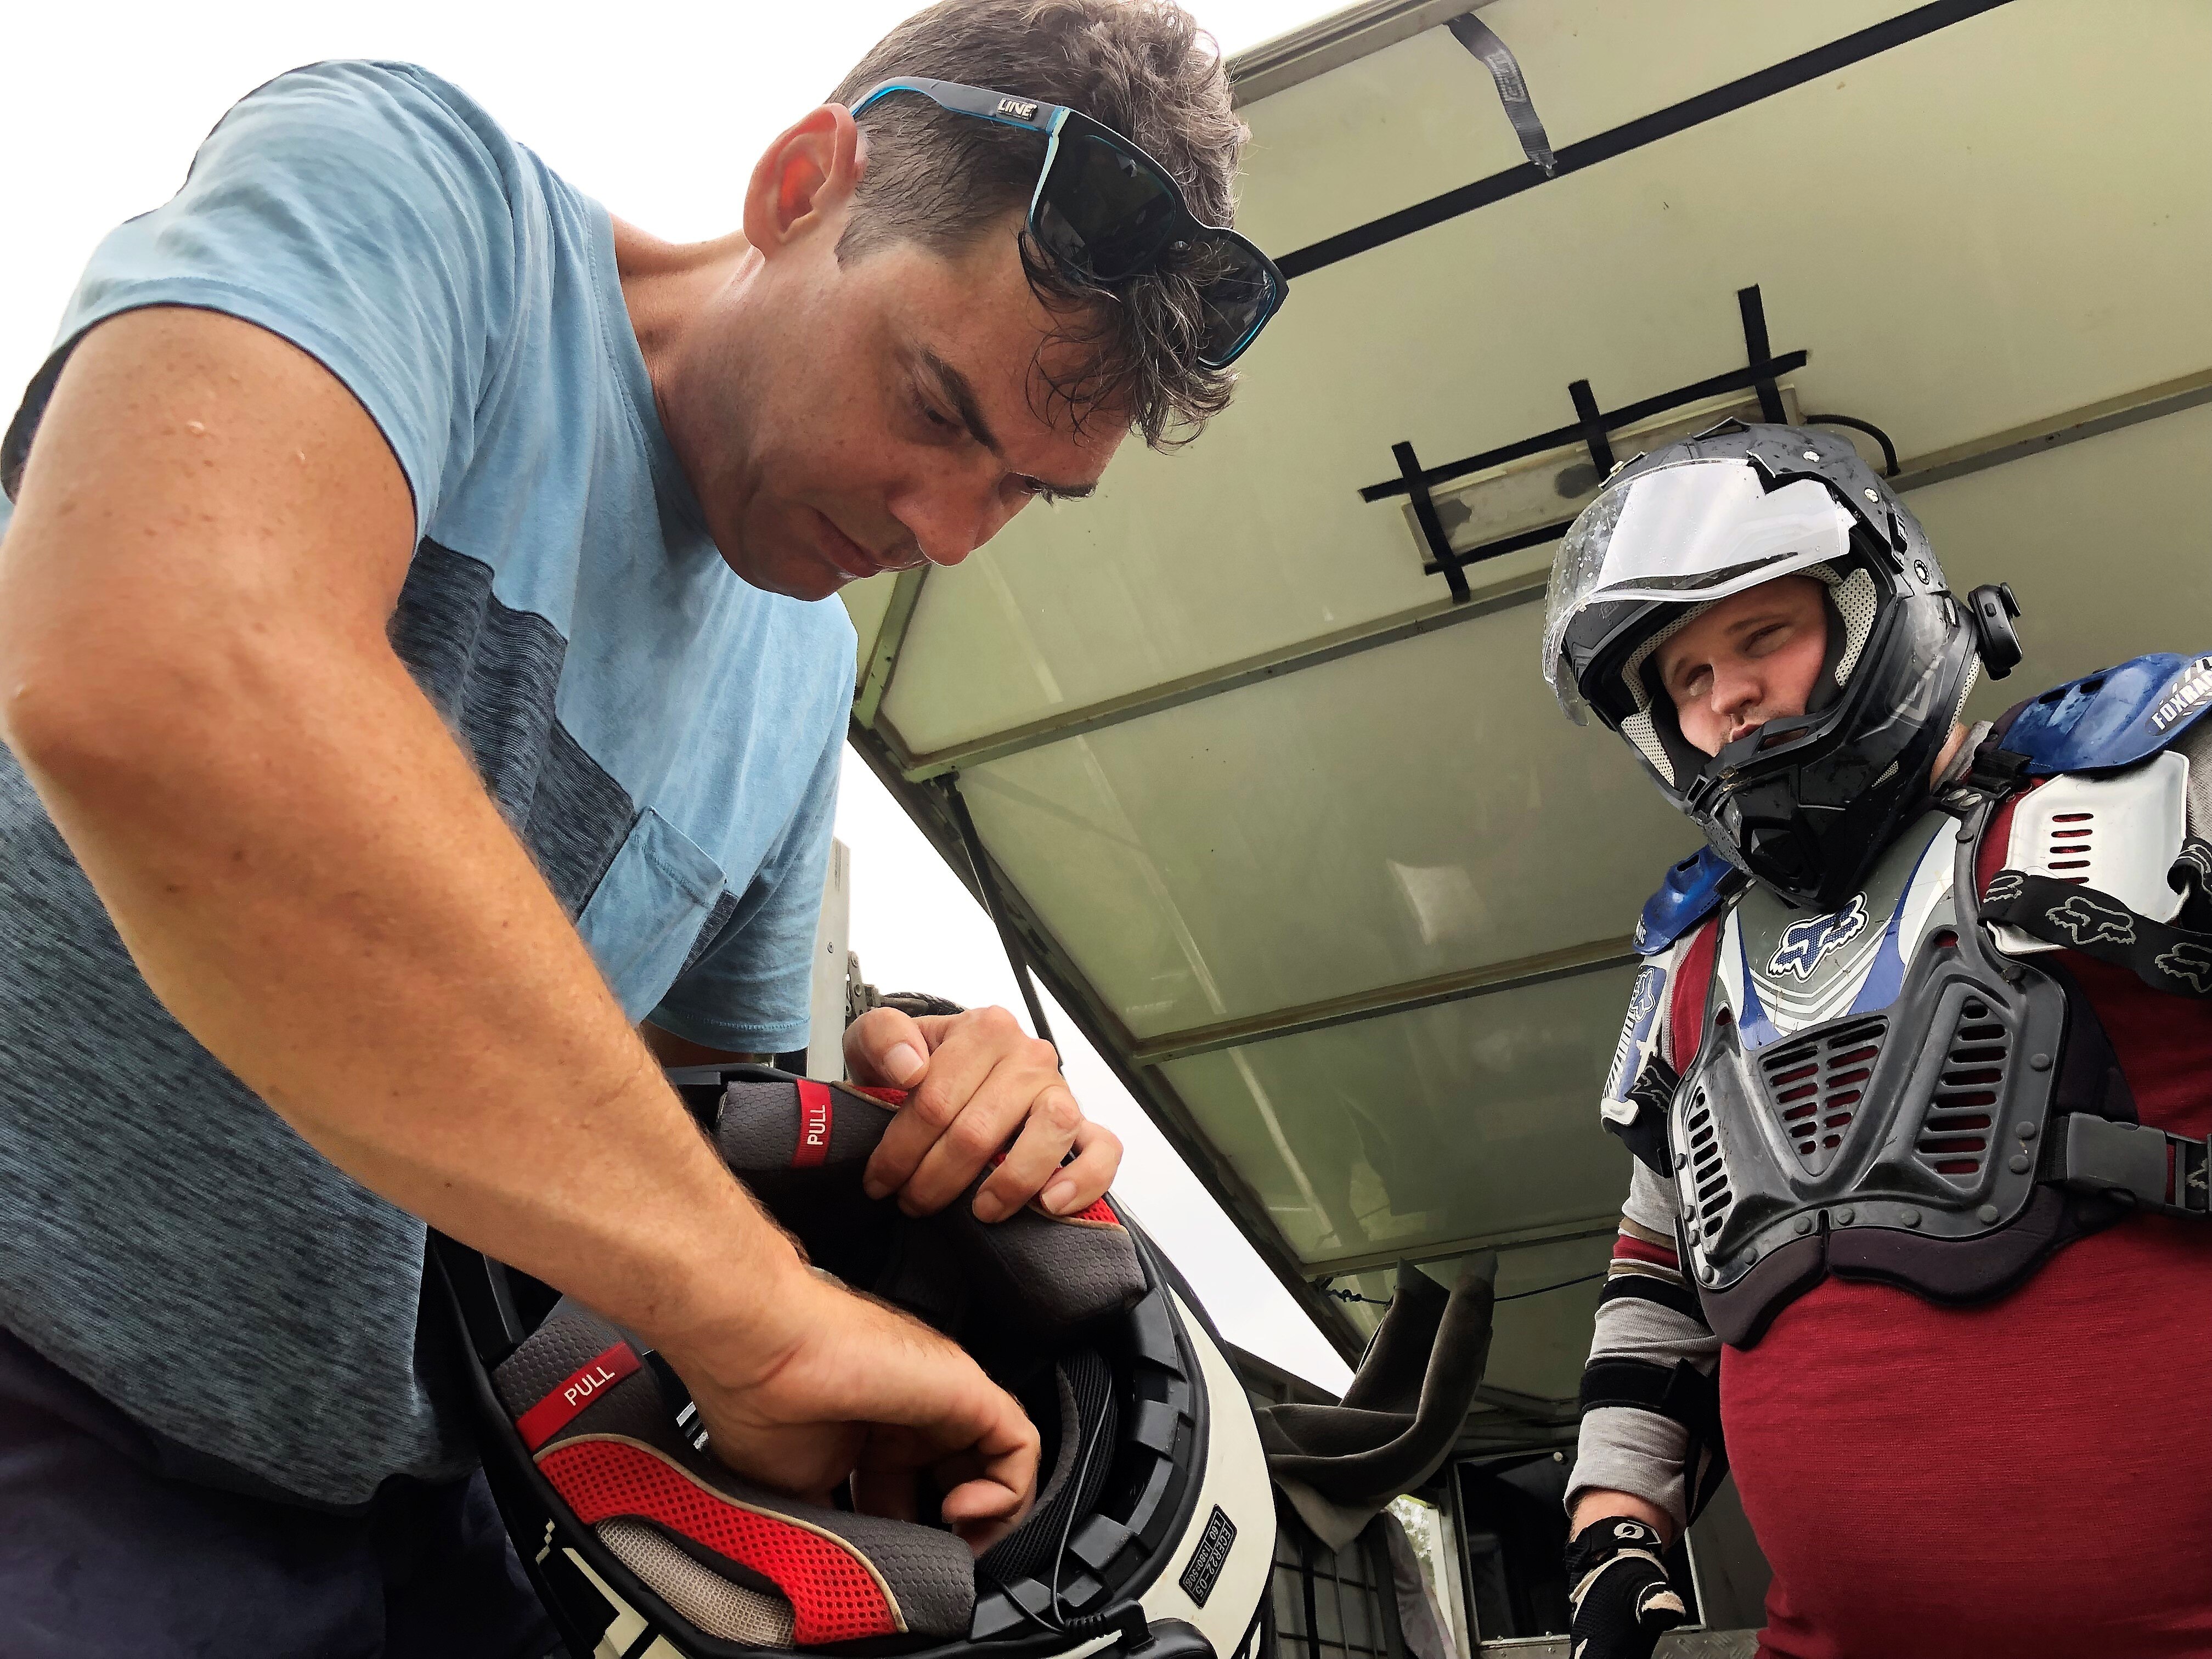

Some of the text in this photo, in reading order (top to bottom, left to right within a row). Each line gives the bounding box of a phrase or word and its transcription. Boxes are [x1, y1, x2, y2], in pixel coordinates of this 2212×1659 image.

[806, 1104, 826, 1145] PULL
[563, 1367, 615, 1406] PULL
[1210, 1519, 1221, 1540] L60
